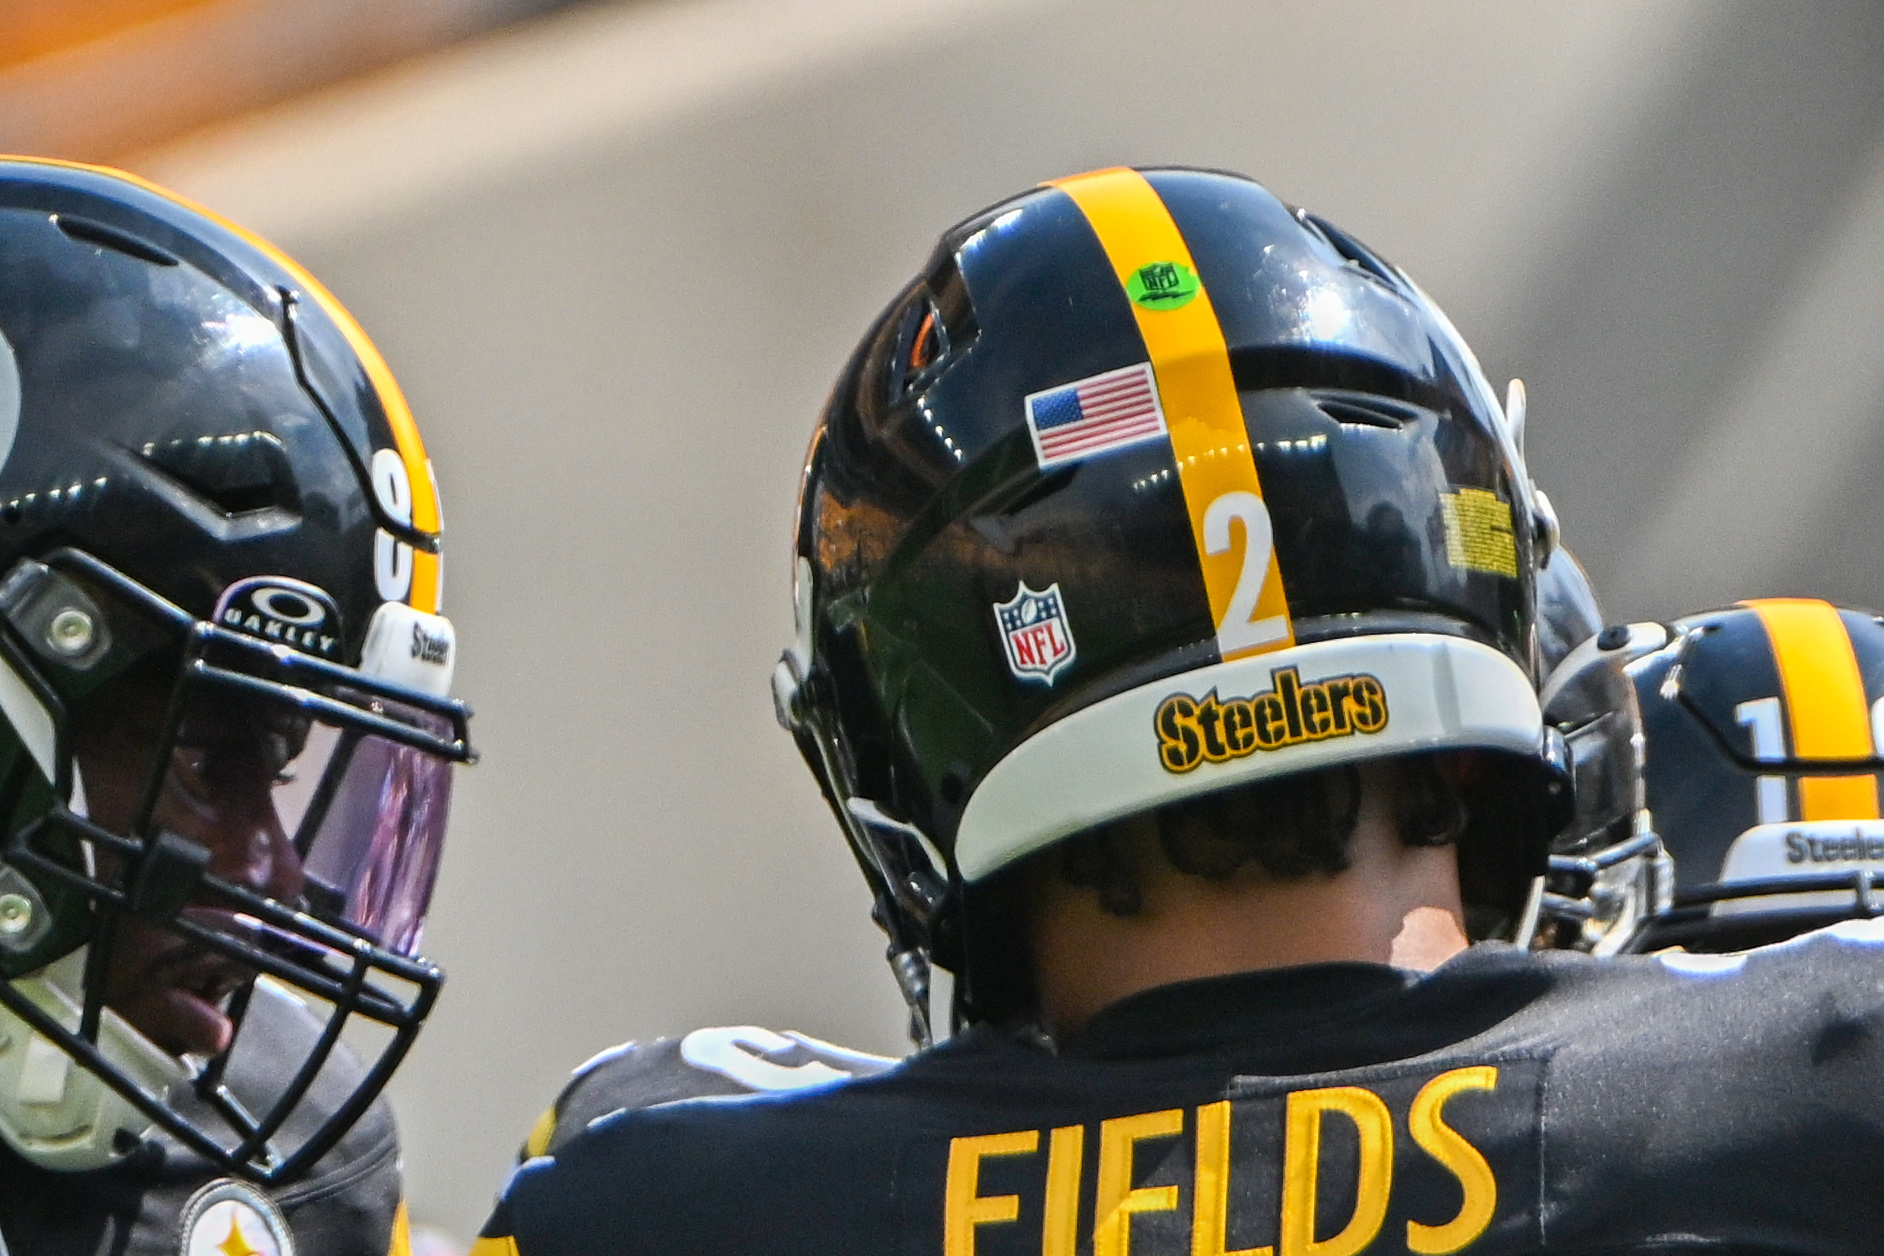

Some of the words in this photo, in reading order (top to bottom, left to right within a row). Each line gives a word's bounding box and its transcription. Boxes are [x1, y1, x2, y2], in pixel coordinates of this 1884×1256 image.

[1203, 490, 1289, 655] 2
[1011, 623, 1066, 666] NFL
[1154, 663, 1389, 772] Steelers
